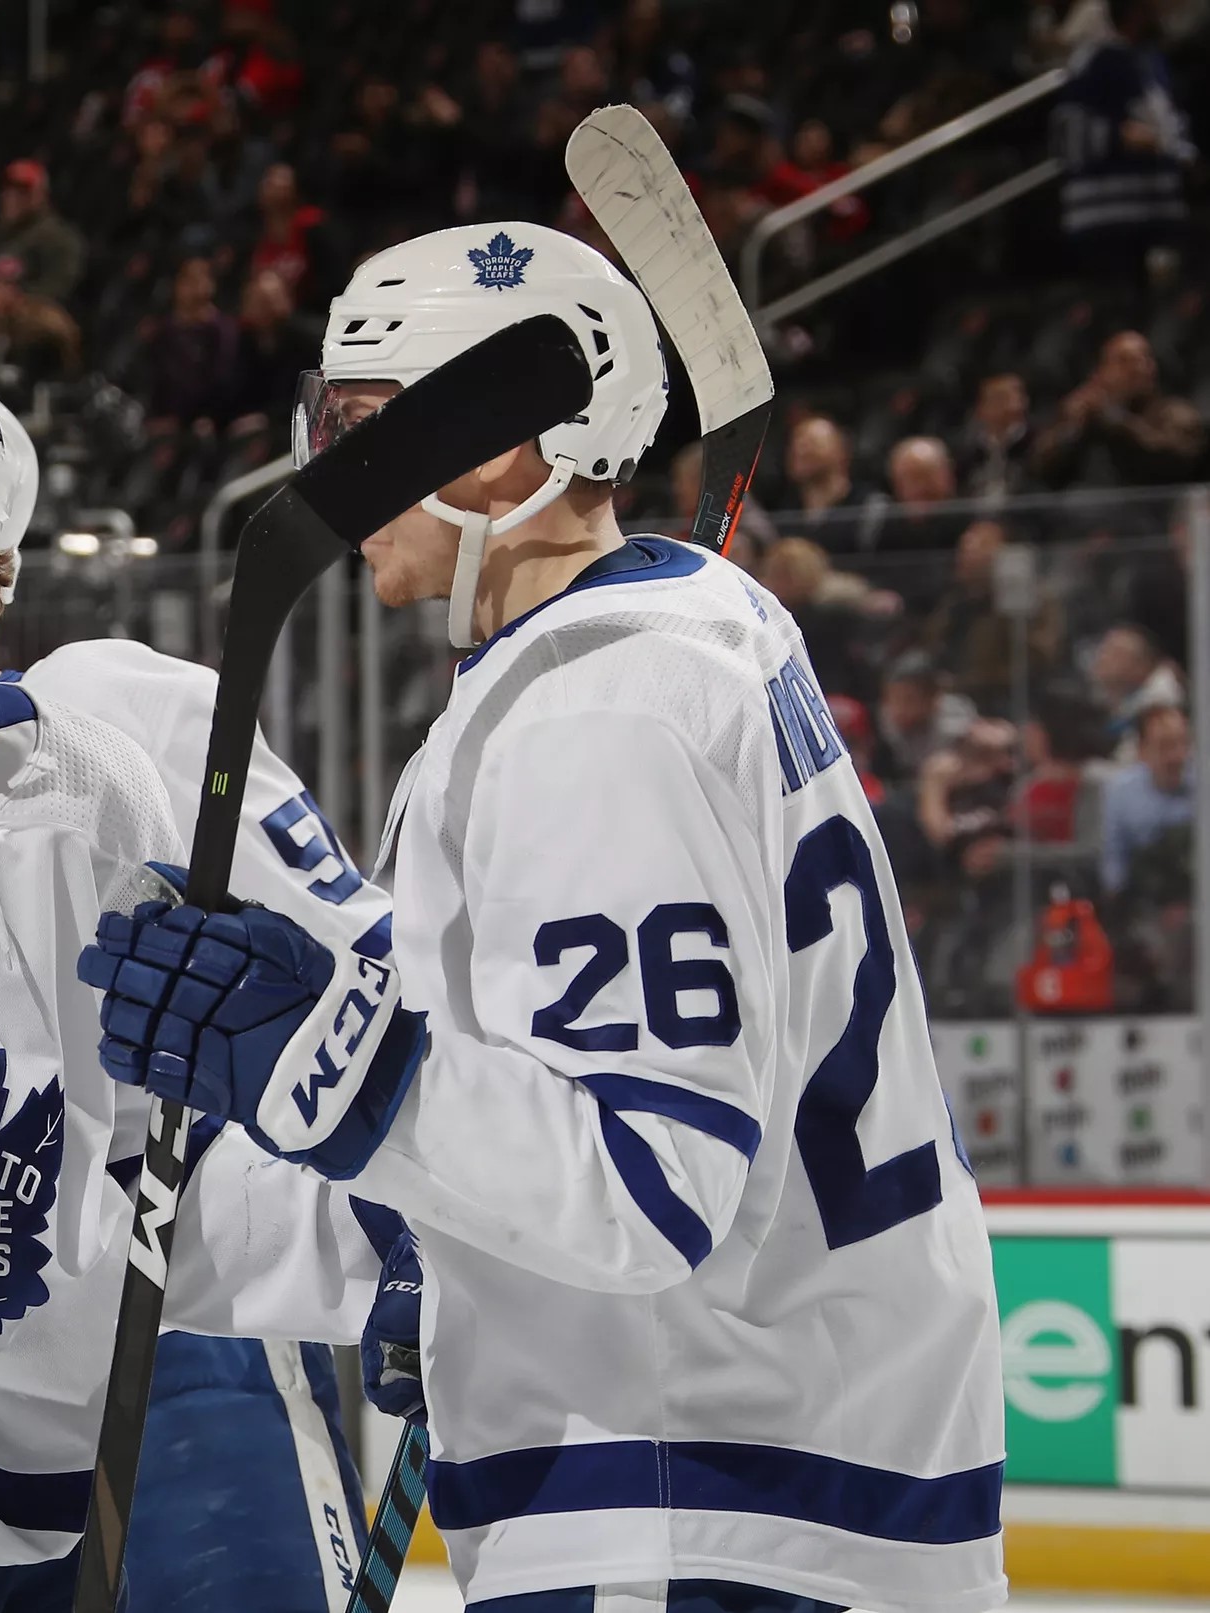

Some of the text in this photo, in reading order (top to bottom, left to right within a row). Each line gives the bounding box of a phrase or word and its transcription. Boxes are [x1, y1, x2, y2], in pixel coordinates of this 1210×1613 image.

[479, 256, 522, 267] TORONTO
[485, 271, 515, 279] LEAFS
[716, 512, 731, 546] QUICK
[531, 902, 742, 1051] 26
[291, 957, 390, 1128] CCM
[784, 814, 943, 1250] 2
[1001, 1299, 1210, 1424] en
[323, 1503, 355, 1592] CCM
